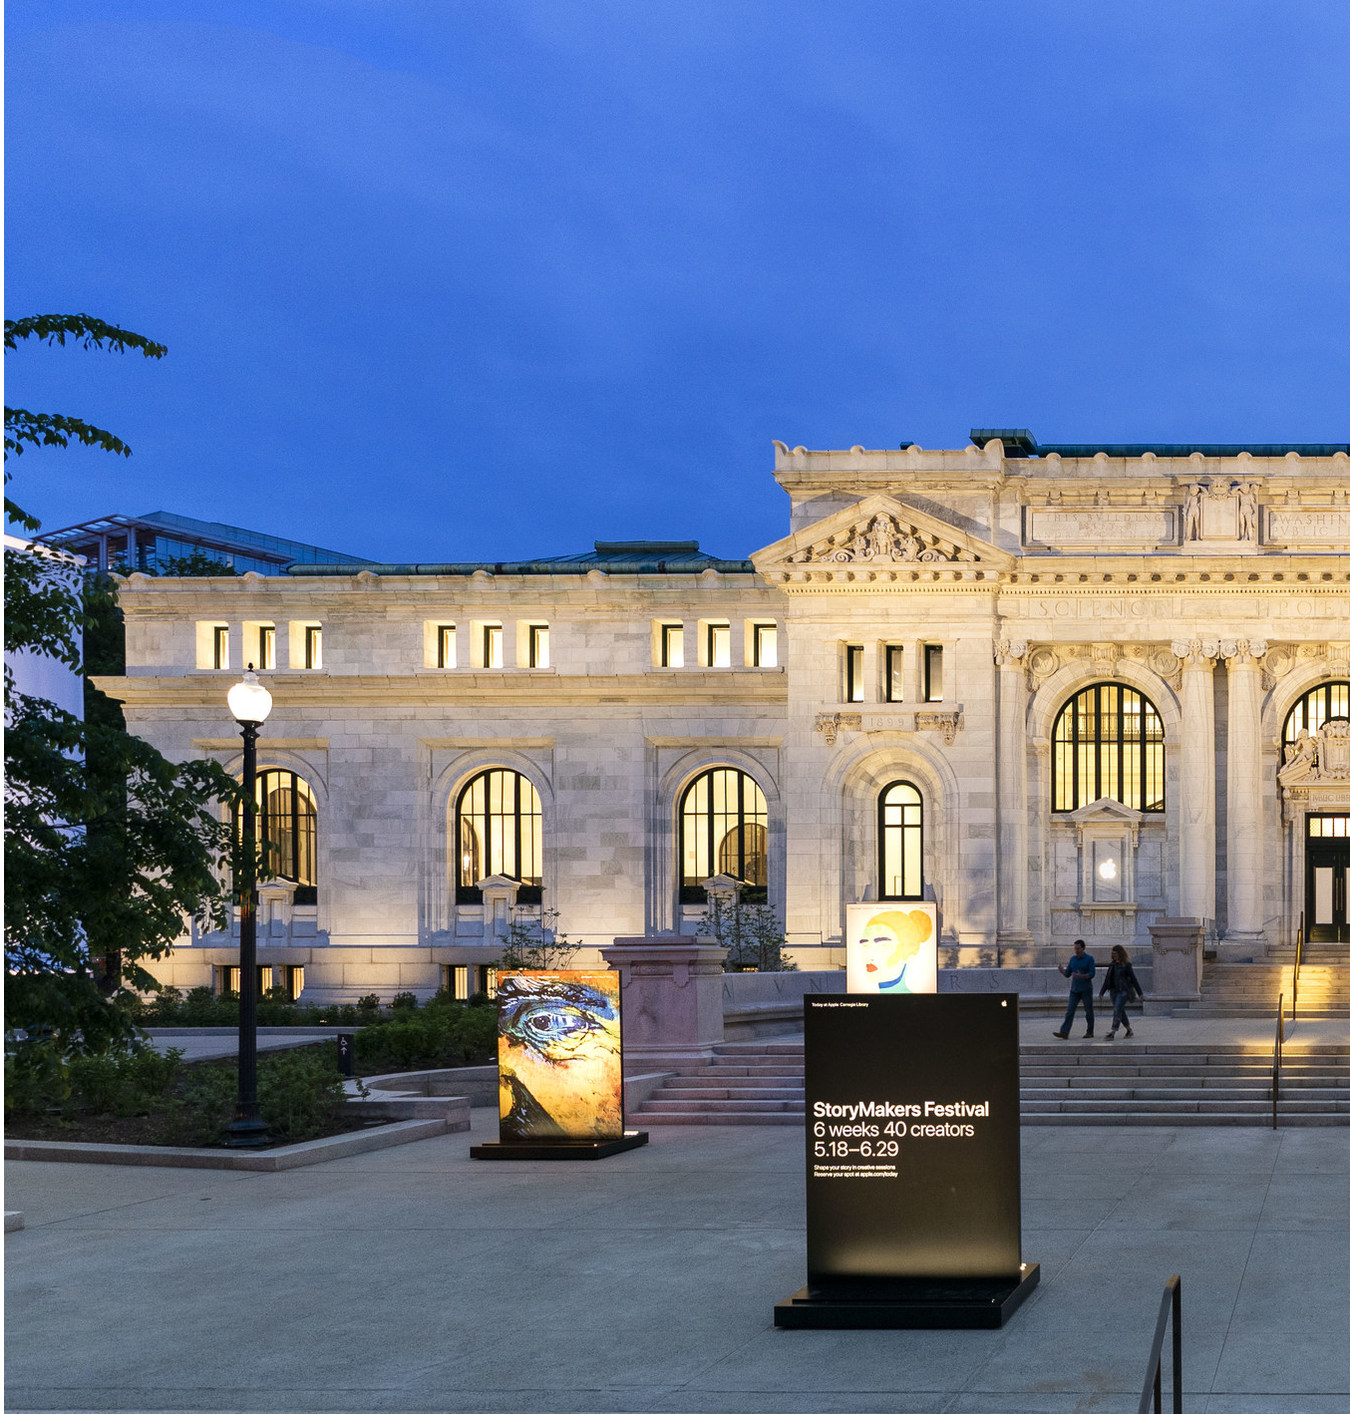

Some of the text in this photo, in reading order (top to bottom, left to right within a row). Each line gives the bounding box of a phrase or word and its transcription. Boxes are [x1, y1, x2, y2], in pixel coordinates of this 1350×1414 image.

[1039, 600, 1165, 616] SCIENCE
[813, 1100, 990, 1121] StoryMakers Festival
[813, 1121, 975, 1137] 6 weeks 40 creators
